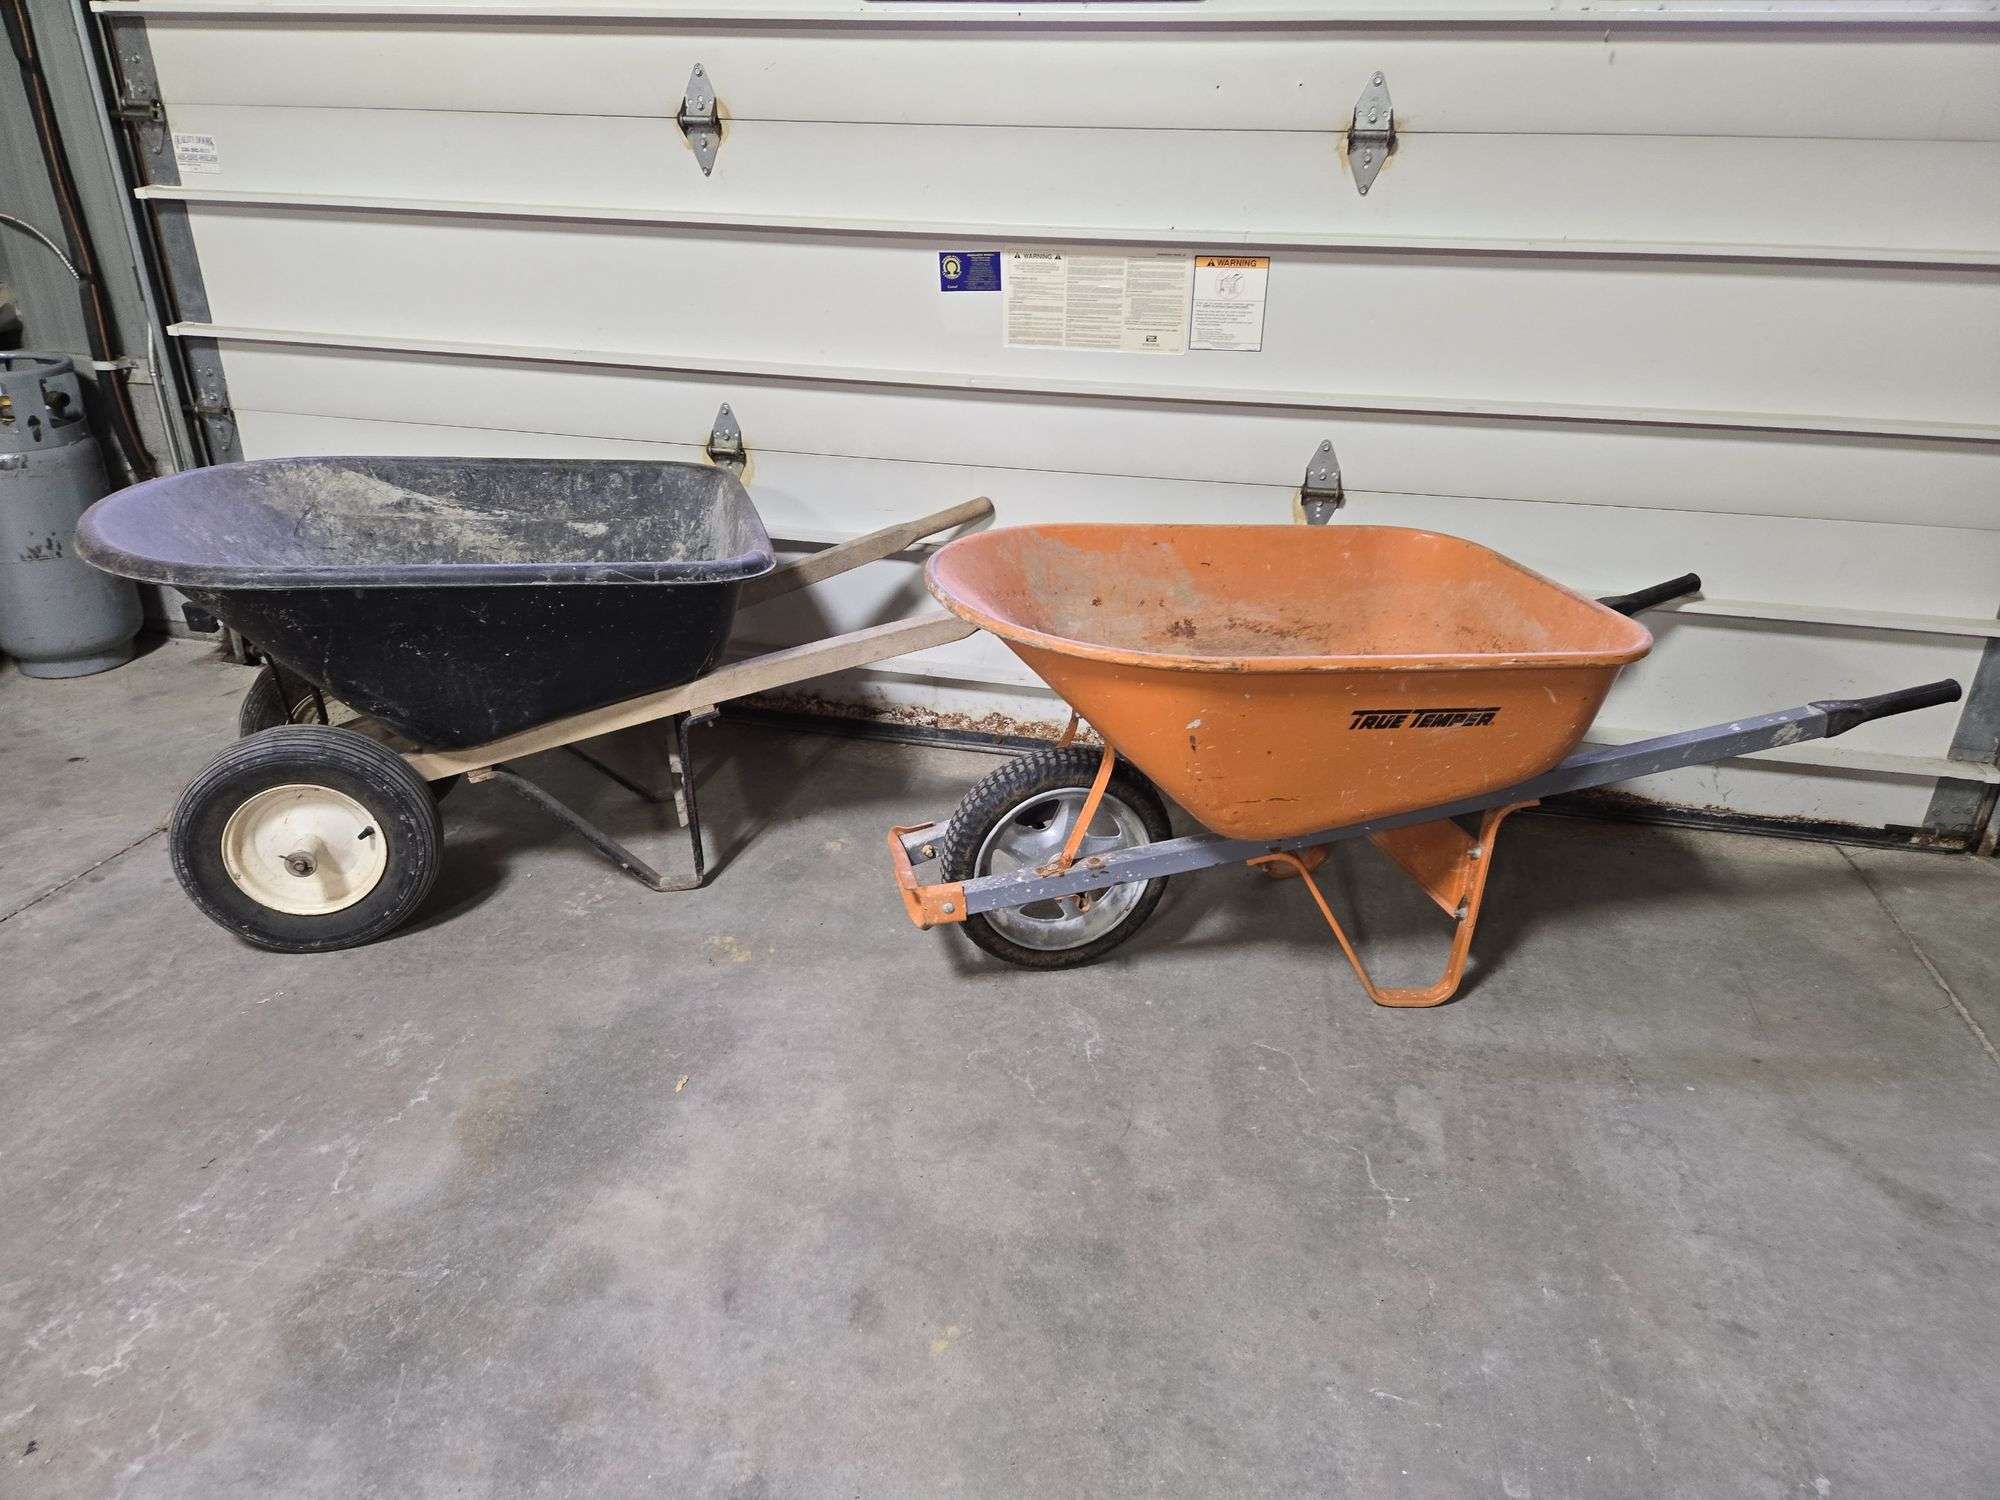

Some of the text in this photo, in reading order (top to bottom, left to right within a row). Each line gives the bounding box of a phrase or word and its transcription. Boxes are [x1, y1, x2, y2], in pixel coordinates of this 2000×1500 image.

[1217, 259, 1257, 267] WARNING
[1349, 707, 1501, 729] TRUE TEMPER
